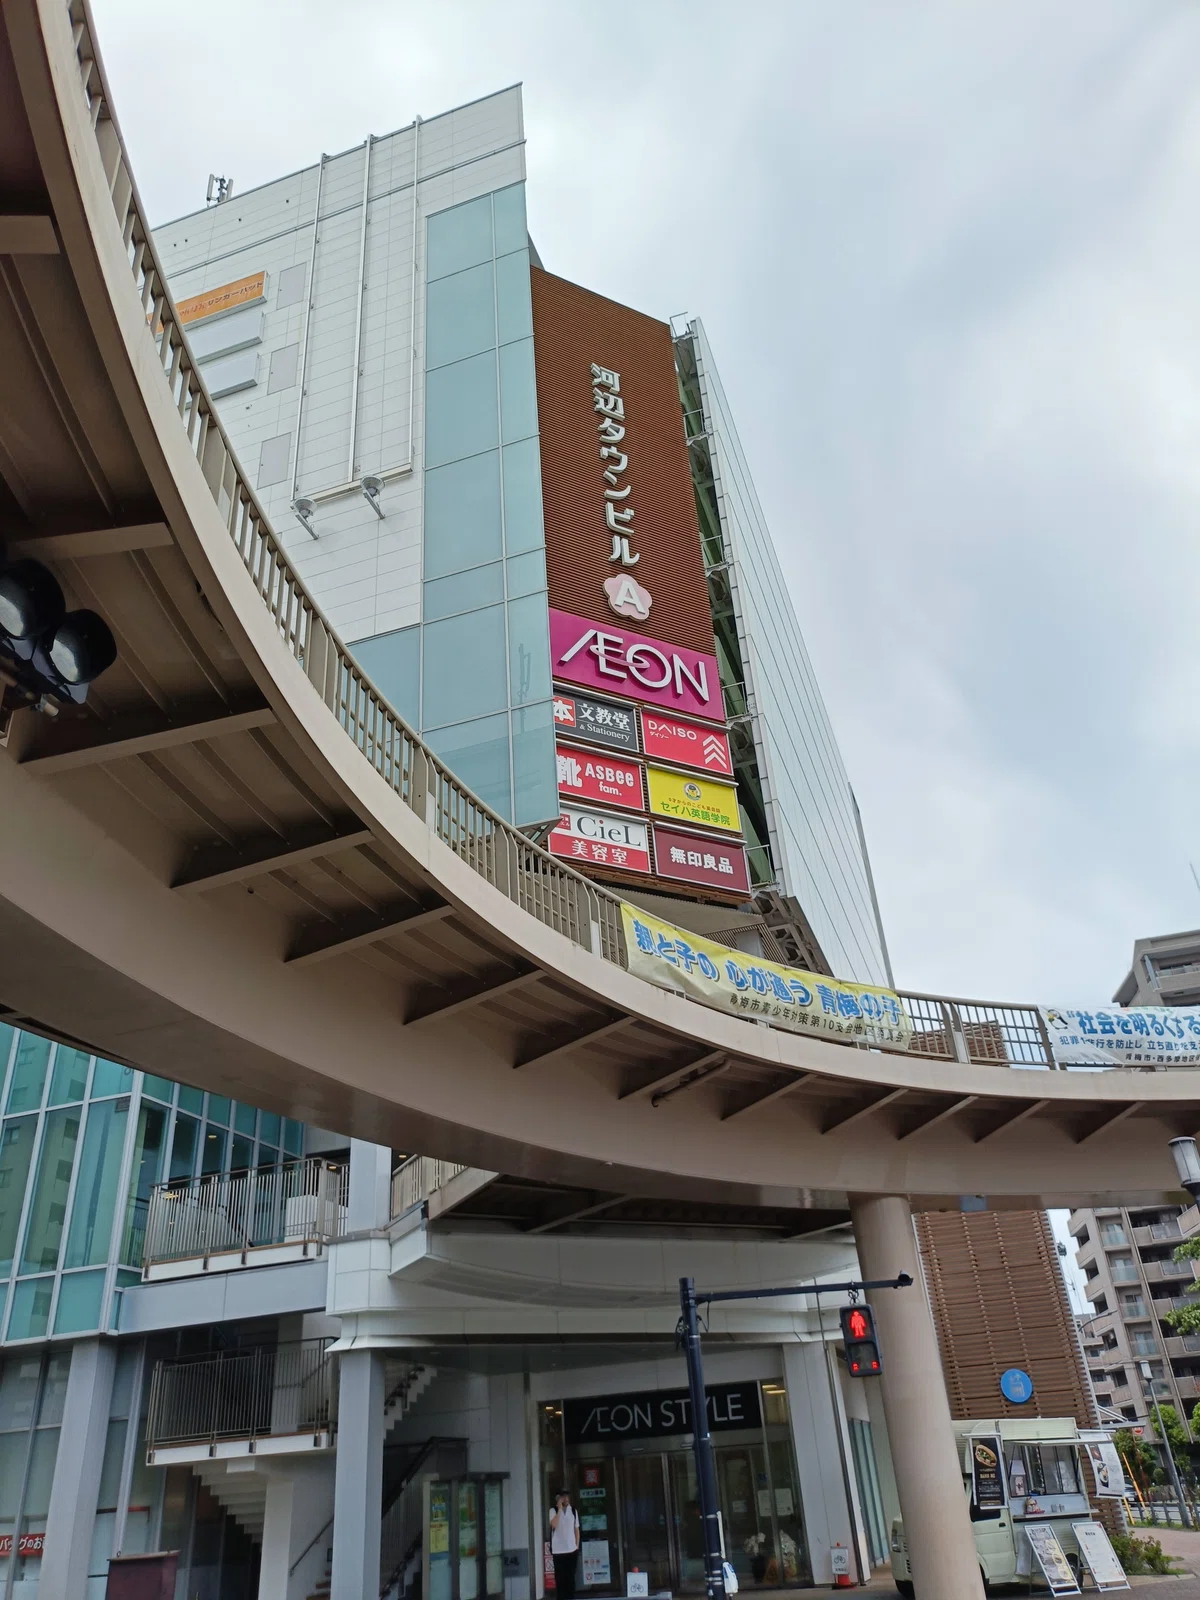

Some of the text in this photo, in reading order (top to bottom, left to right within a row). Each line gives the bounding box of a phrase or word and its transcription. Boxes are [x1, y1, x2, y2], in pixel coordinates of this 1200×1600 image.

[591, 363, 640, 567] 河辺タウンビル
[577, 703, 631, 731] 文教堂
[648, 719, 697, 740] DAISO
[586, 723, 631, 742] Stationery
[649, 731, 669, 739] ダイソー
[585, 763, 634, 787] ASBee
[598, 781, 622, 796] fam.
[660, 801, 731, 826] セイハ英語学院
[577, 816, 641, 847] CieL
[572, 840, 628, 865] 美容室
[670, 846, 734, 875] 無印良品
[633, 918, 904, 1025] 親と子の 心が通う 青梅の子
